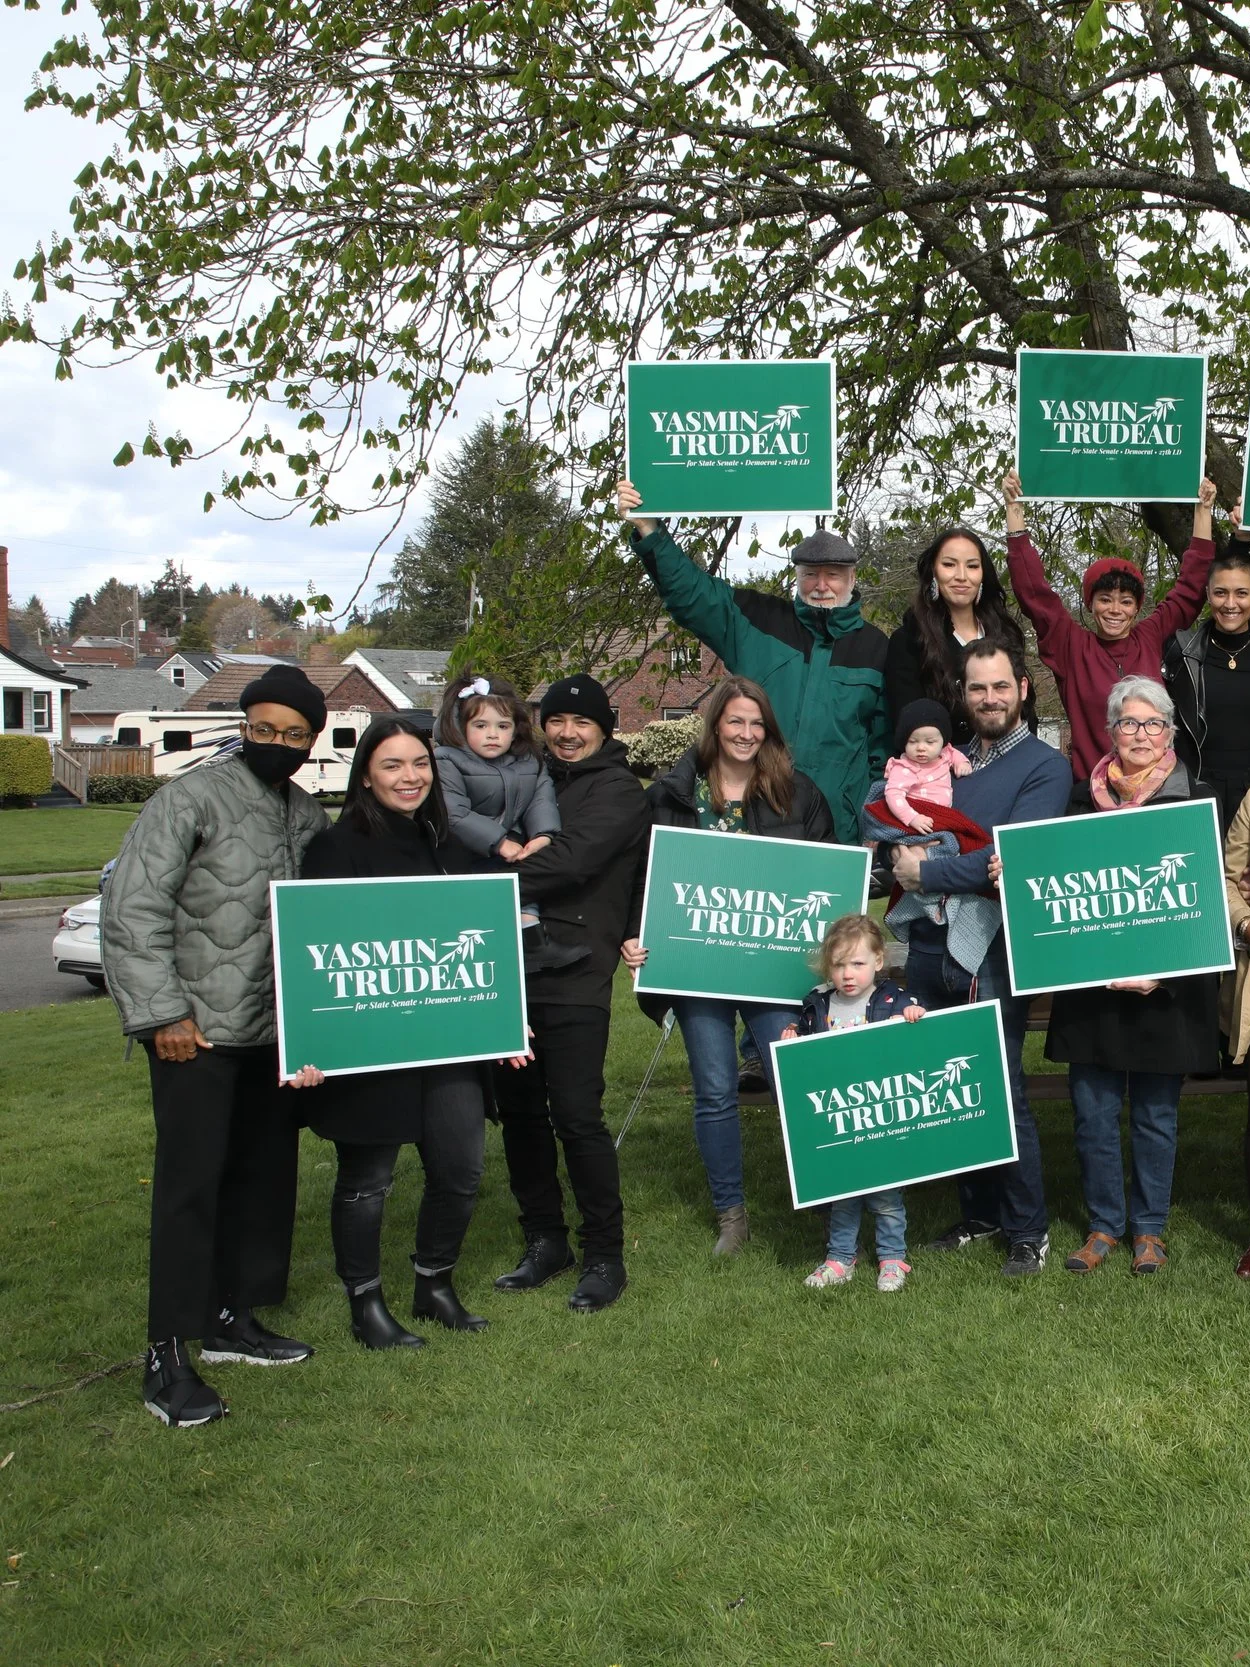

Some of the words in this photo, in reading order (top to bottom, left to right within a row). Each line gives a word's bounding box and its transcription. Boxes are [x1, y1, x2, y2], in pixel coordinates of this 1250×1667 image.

[650, 411, 758, 433] YASMIN
[1039, 400, 1138, 422] YASMIN
[666, 433, 809, 456] TRUDEAU
[1053, 422, 1182, 446] TRUDEAU
[1071, 447, 1082, 455] for
[686, 460, 698, 468] for
[783, 459, 798, 467] 27th
[1026, 865, 1141, 901] YASMIN
[672, 883, 787, 915] YASMIN
[1045, 882, 1197, 924] TRUDEAU
[1070, 926, 1082, 935] for
[1082, 924, 1101, 932] State
[1101, 921, 1126, 930] Senate
[1132, 916, 1167, 926] Democrat
[1173, 912, 1189, 921] 27th
[1191, 911, 1202, 919] LD
[307, 938, 436, 971] YASMIN
[705, 937, 717, 945] for
[717, 939, 736, 947] State
[737, 940, 761, 949] Senate
[767, 943, 801, 953] Democrat
[328, 962, 495, 999] TRUDEAU
[355, 1002, 368, 1012] for
[369, 1001, 390, 1009] State
[391, 999, 418, 1008] Senate
[424, 995, 461, 1005] Democrat
[468, 993, 485, 1003] 27th
[486, 992, 498, 1000] LD
[806, 1070, 926, 1114] YASMIN
[828, 1083, 981, 1135] TRUDEAU
[854, 1136, 866, 1145] for
[867, 1132, 885, 1141] State
[886, 1126, 911, 1136] Senate
[917, 1117, 951, 1130] Democrat
[958, 1112, 973, 1122] 27th
[975, 1110, 985, 1118] LD
